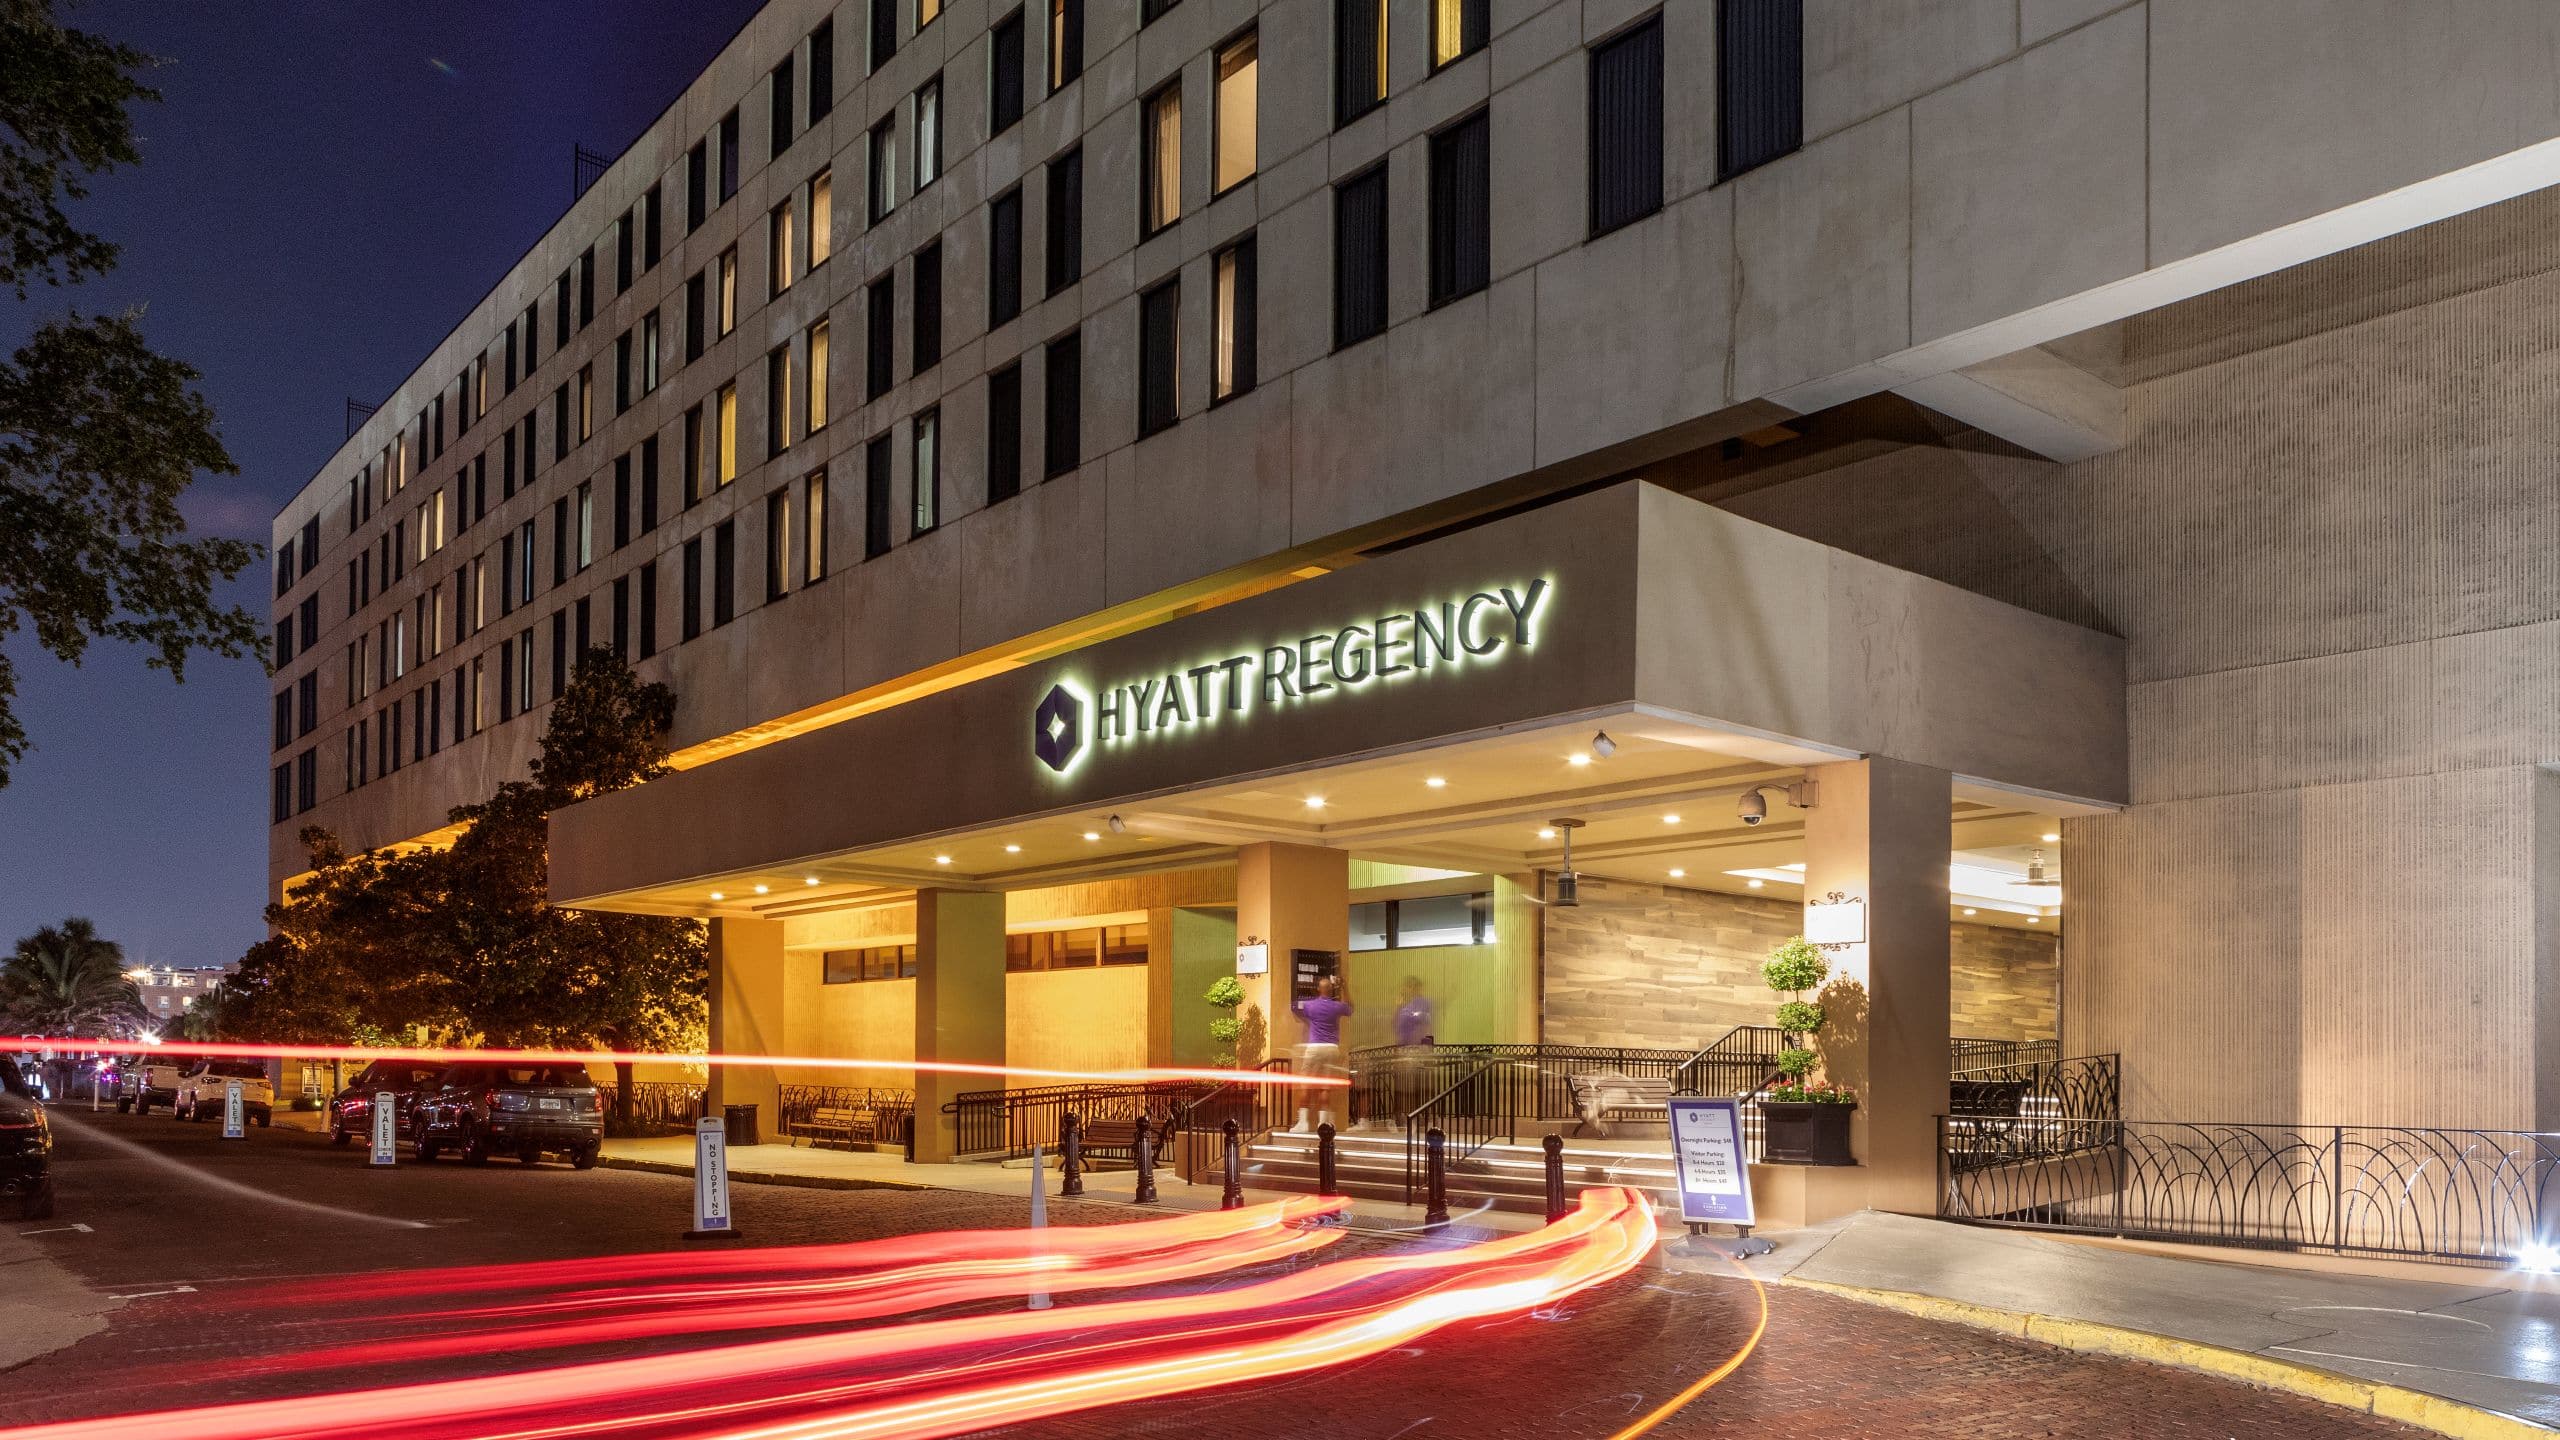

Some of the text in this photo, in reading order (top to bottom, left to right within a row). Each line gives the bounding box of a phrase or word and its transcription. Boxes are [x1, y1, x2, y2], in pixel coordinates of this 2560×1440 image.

[1097, 578, 1549, 740] HYATT REGENCY
[709, 1144, 717, 1158] NO
[710, 1160, 719, 1216] STOPPING
